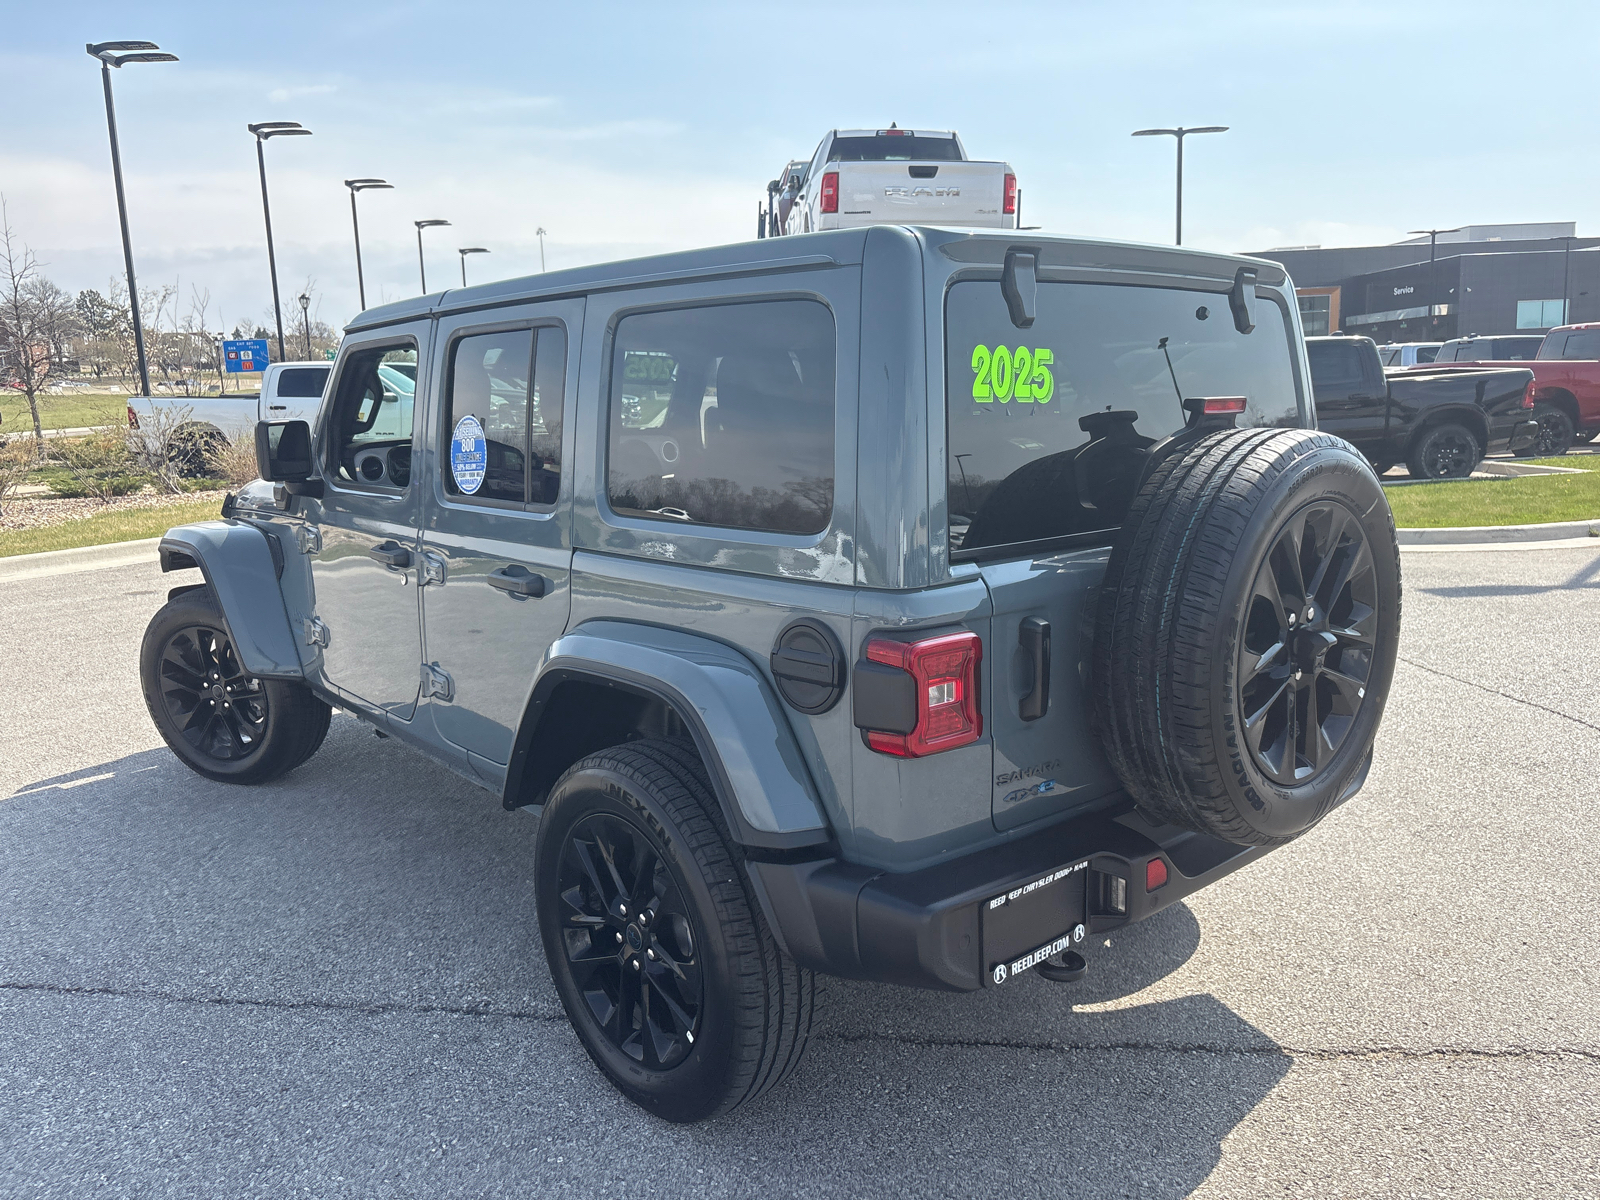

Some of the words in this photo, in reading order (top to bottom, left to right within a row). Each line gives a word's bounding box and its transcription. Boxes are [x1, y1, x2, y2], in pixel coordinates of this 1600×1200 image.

[884, 186, 961, 197] RAM
[1393, 286, 1414, 296] Service
[971, 344, 1054, 404] 2025
[461, 438, 475, 452] 800
[996, 759, 1062, 786] SAHARA
[608, 783, 672, 848] NEXEN
[990, 895, 1006, 910] REED
[1023, 874, 1053, 895] CHRYSLER
[1011, 935, 1070, 976] REEDJEEP.COM
